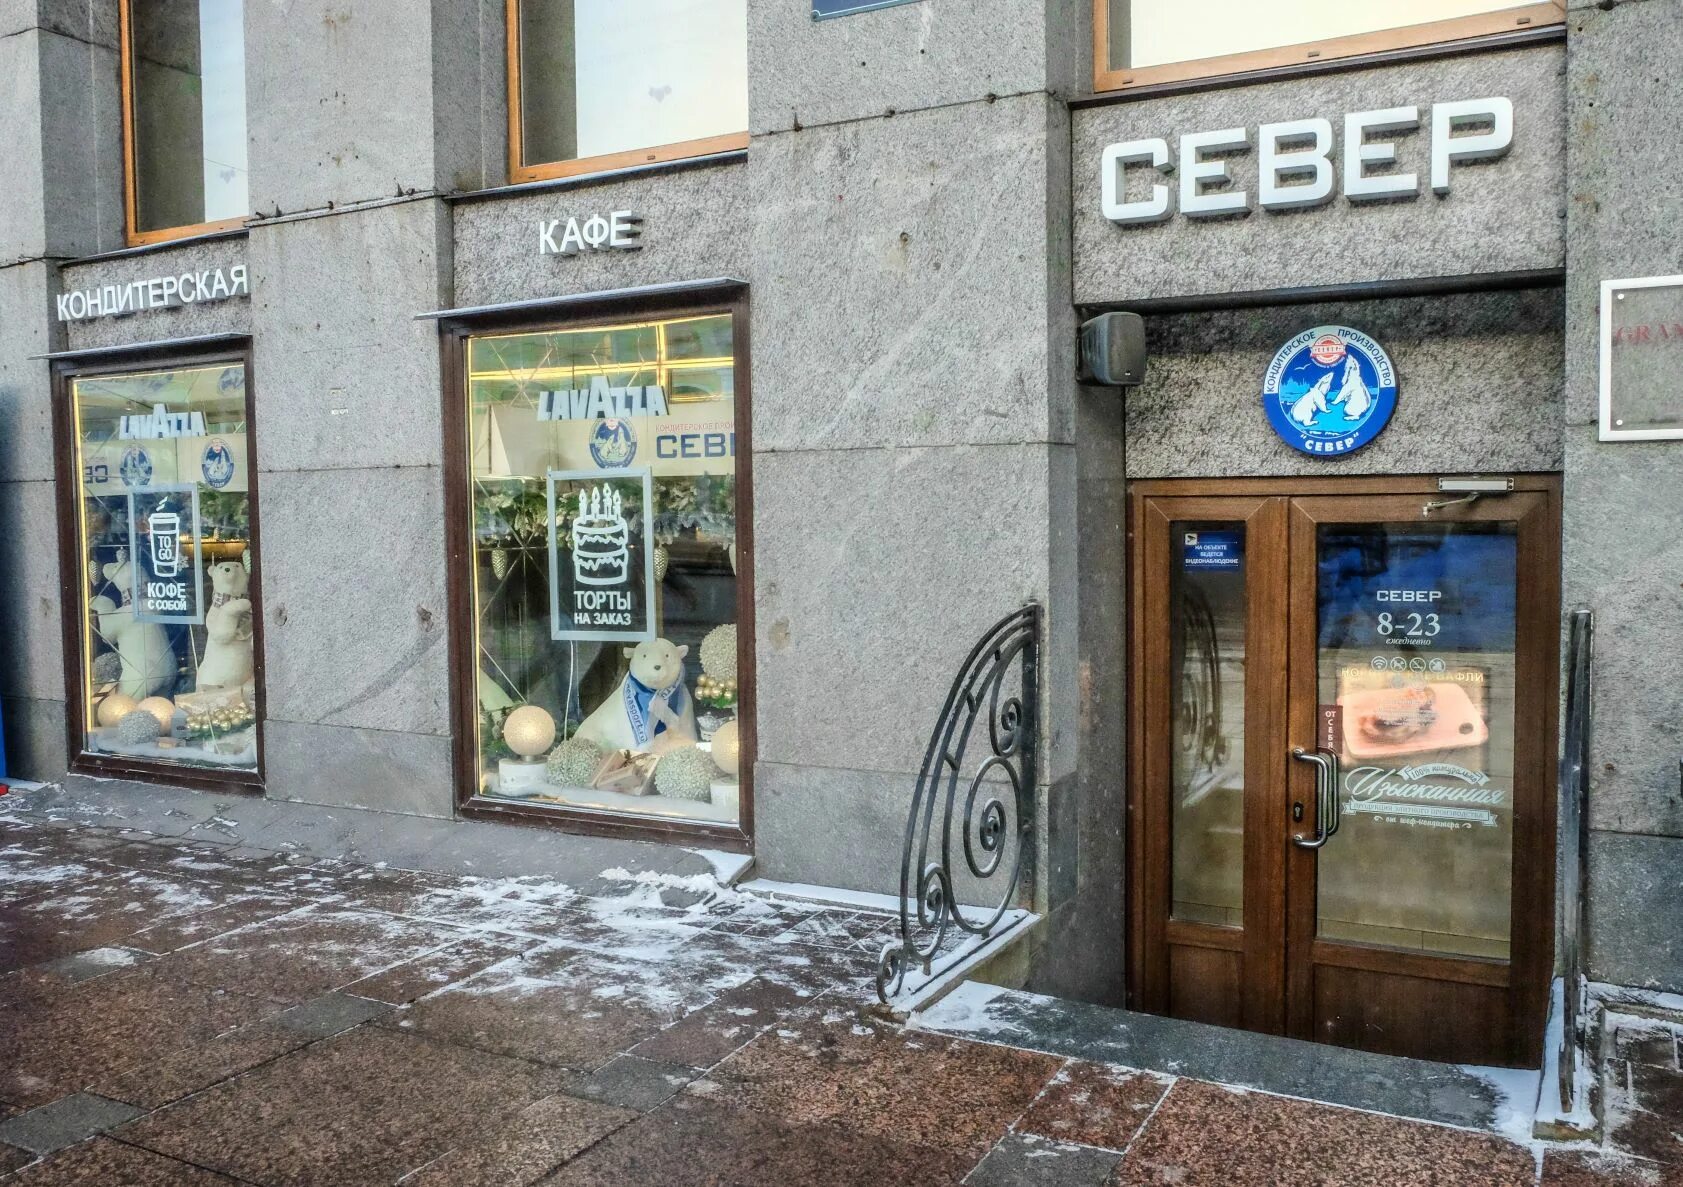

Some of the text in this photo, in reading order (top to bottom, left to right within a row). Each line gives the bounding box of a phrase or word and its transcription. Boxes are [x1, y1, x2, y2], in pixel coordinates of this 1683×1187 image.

[1101, 96, 1514, 224] СЕВЕР
[539, 210, 633, 255] КАФЕ
[57, 264, 249, 321] КОНДИТЕРСКАЯ
[1266, 328, 1392, 392] КОНДИТЕРСКОЕ ПРОИЗВОДСТВО
[537, 376, 669, 421] LAVAZZA
[119, 403, 208, 440] LAVAZZA
[655, 422, 713, 432] КОНДИТЕРСКОЕ
[157, 535, 172, 549] TO
[158, 548, 173, 560] GO
[147, 582, 186, 599] КОФЕ
[1376, 590, 1442, 602] СЕВЕР
[147, 598, 187, 611] С СОБОЙ
[573, 590, 631, 610] ТОРТЫ
[574, 612, 632, 626] НА ЗАКАЗ
[1376, 612, 1441, 637] 8-23
[1385, 637, 1432, 645] ежедневно
[1324, 710, 1337, 718] ОТ
[1411, 765, 1431, 779] 100%
[1344, 766, 1507, 805] Изысканная
